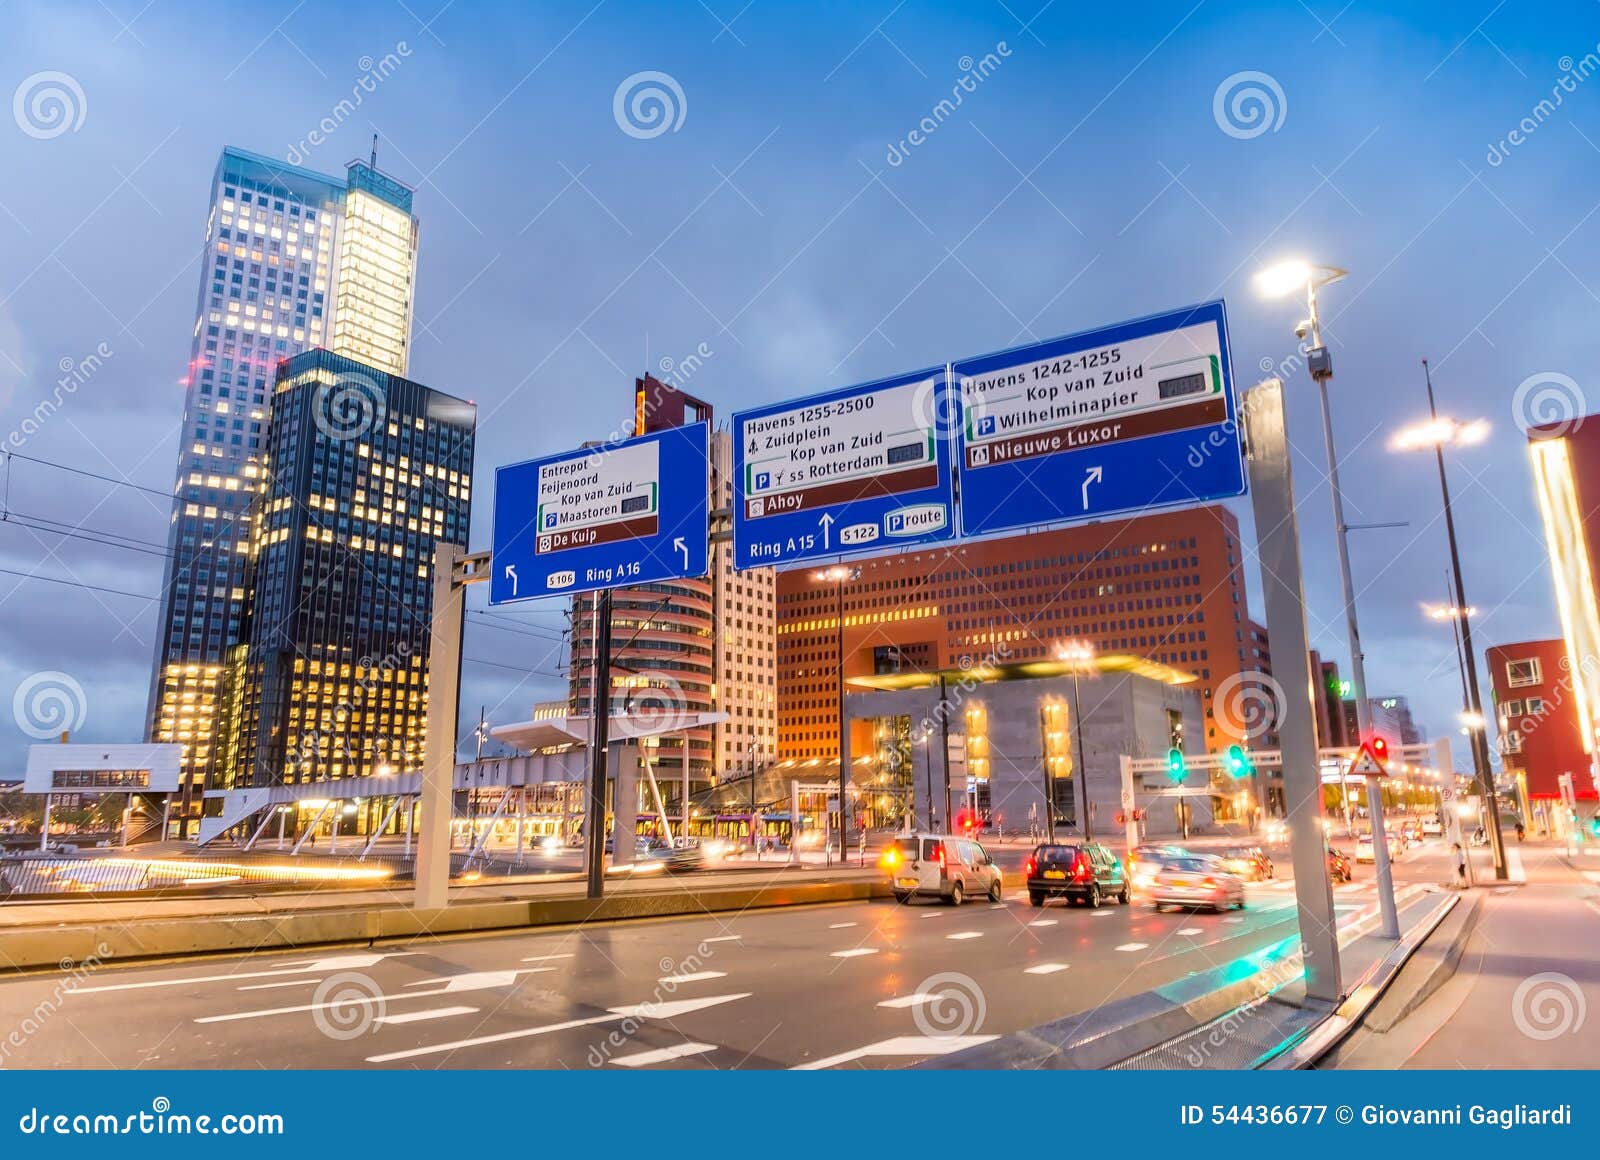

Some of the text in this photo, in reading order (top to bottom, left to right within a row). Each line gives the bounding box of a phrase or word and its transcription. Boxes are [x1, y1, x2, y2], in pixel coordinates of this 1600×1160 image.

[966, 348, 1121, 395] Havens 1242-1255
[1026, 365, 1143, 402] Kop van Zuid
[747, 396, 874, 434] Havens 1255-2500
[1000, 390, 1138, 430] Wilhelminapier
[765, 425, 831, 449] Zuidplein
[790, 431, 882, 462] Kop van Zuid
[994, 424, 1121, 460] Nieuwe Luxor
[542, 460, 588, 479] Entrepot
[790, 468, 803, 481] ss
[809, 453, 883, 478] Rotterdam
[541, 473, 598, 494] Feijenoord
[561, 482, 632, 506] Kop van Zuid
[559, 505, 618, 524] Maastoren
[768, 494, 803, 511] Ahoy
[905, 510, 941, 527] route
[553, 529, 597, 547] De Kuip
[750, 542, 781, 557] Ring
[586, 567, 612, 582] Ring
